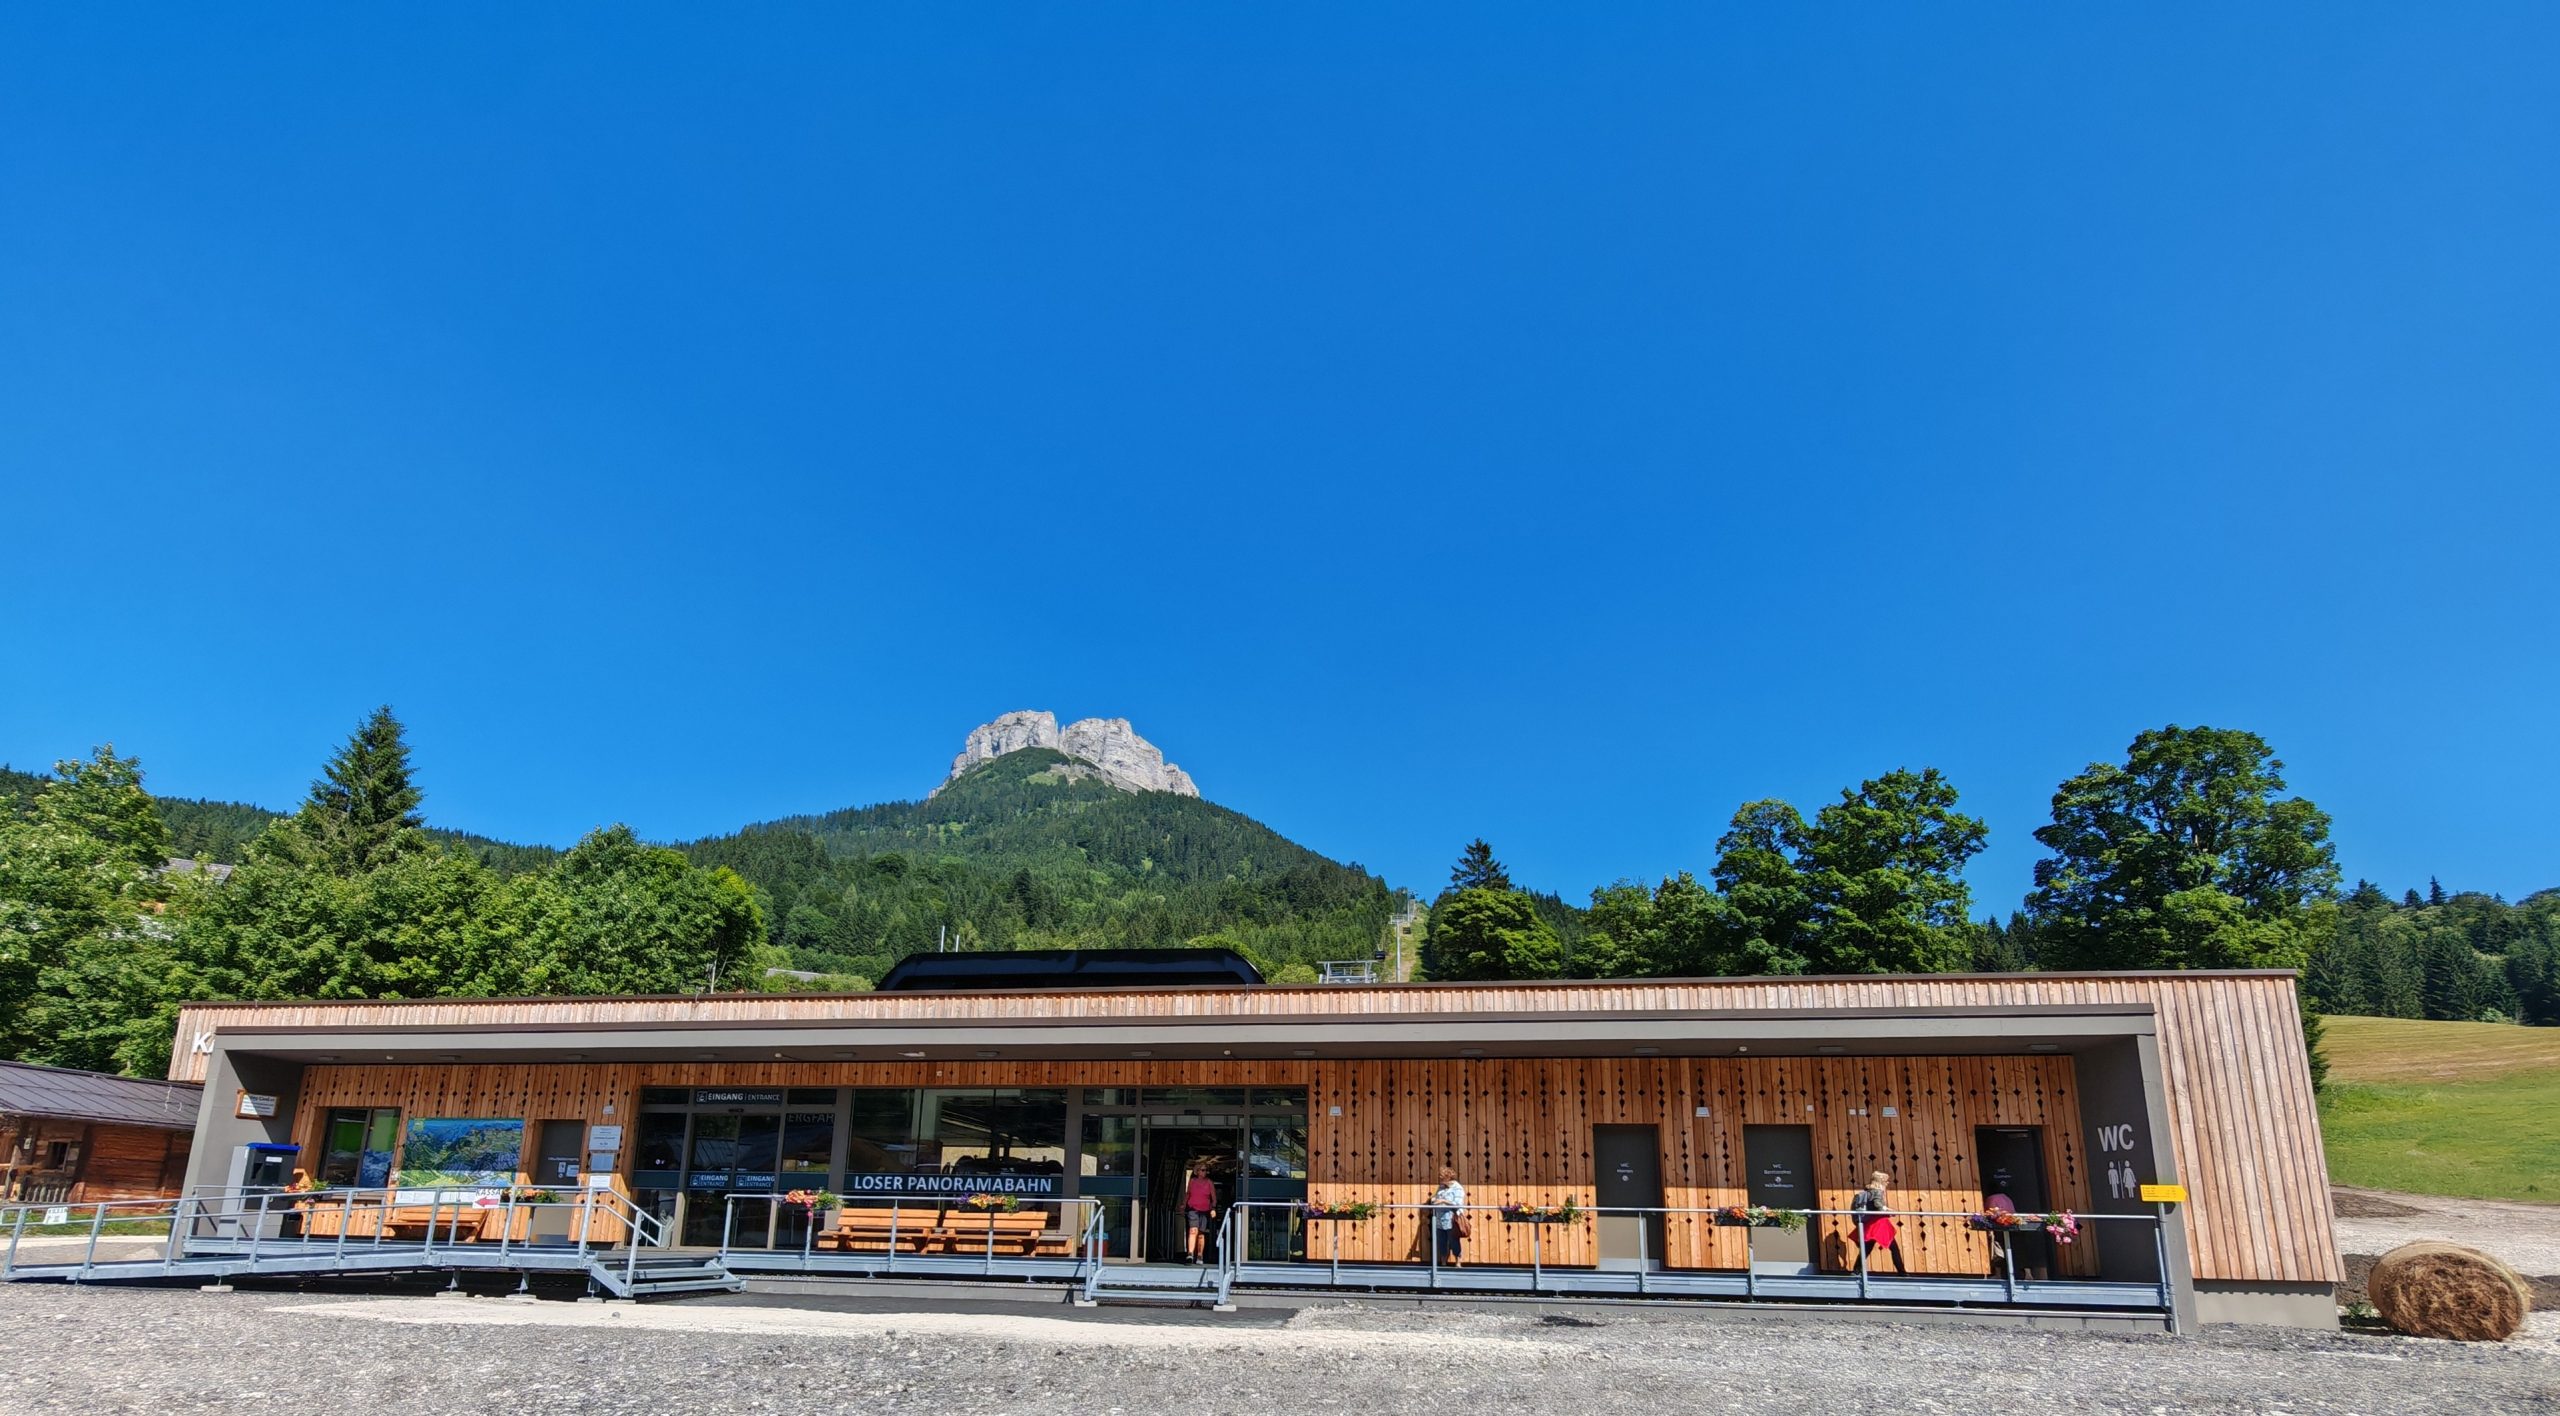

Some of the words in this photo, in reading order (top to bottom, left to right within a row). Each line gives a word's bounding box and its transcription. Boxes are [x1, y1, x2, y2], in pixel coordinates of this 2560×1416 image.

[708, 1092, 744, 1101] EINGANG
[2098, 1124, 2135, 1152] WC
[854, 1175, 903, 1190] LOSER
[907, 1176, 1052, 1192] PANORAMABAHN
[476, 1188, 502, 1197] KASSA
